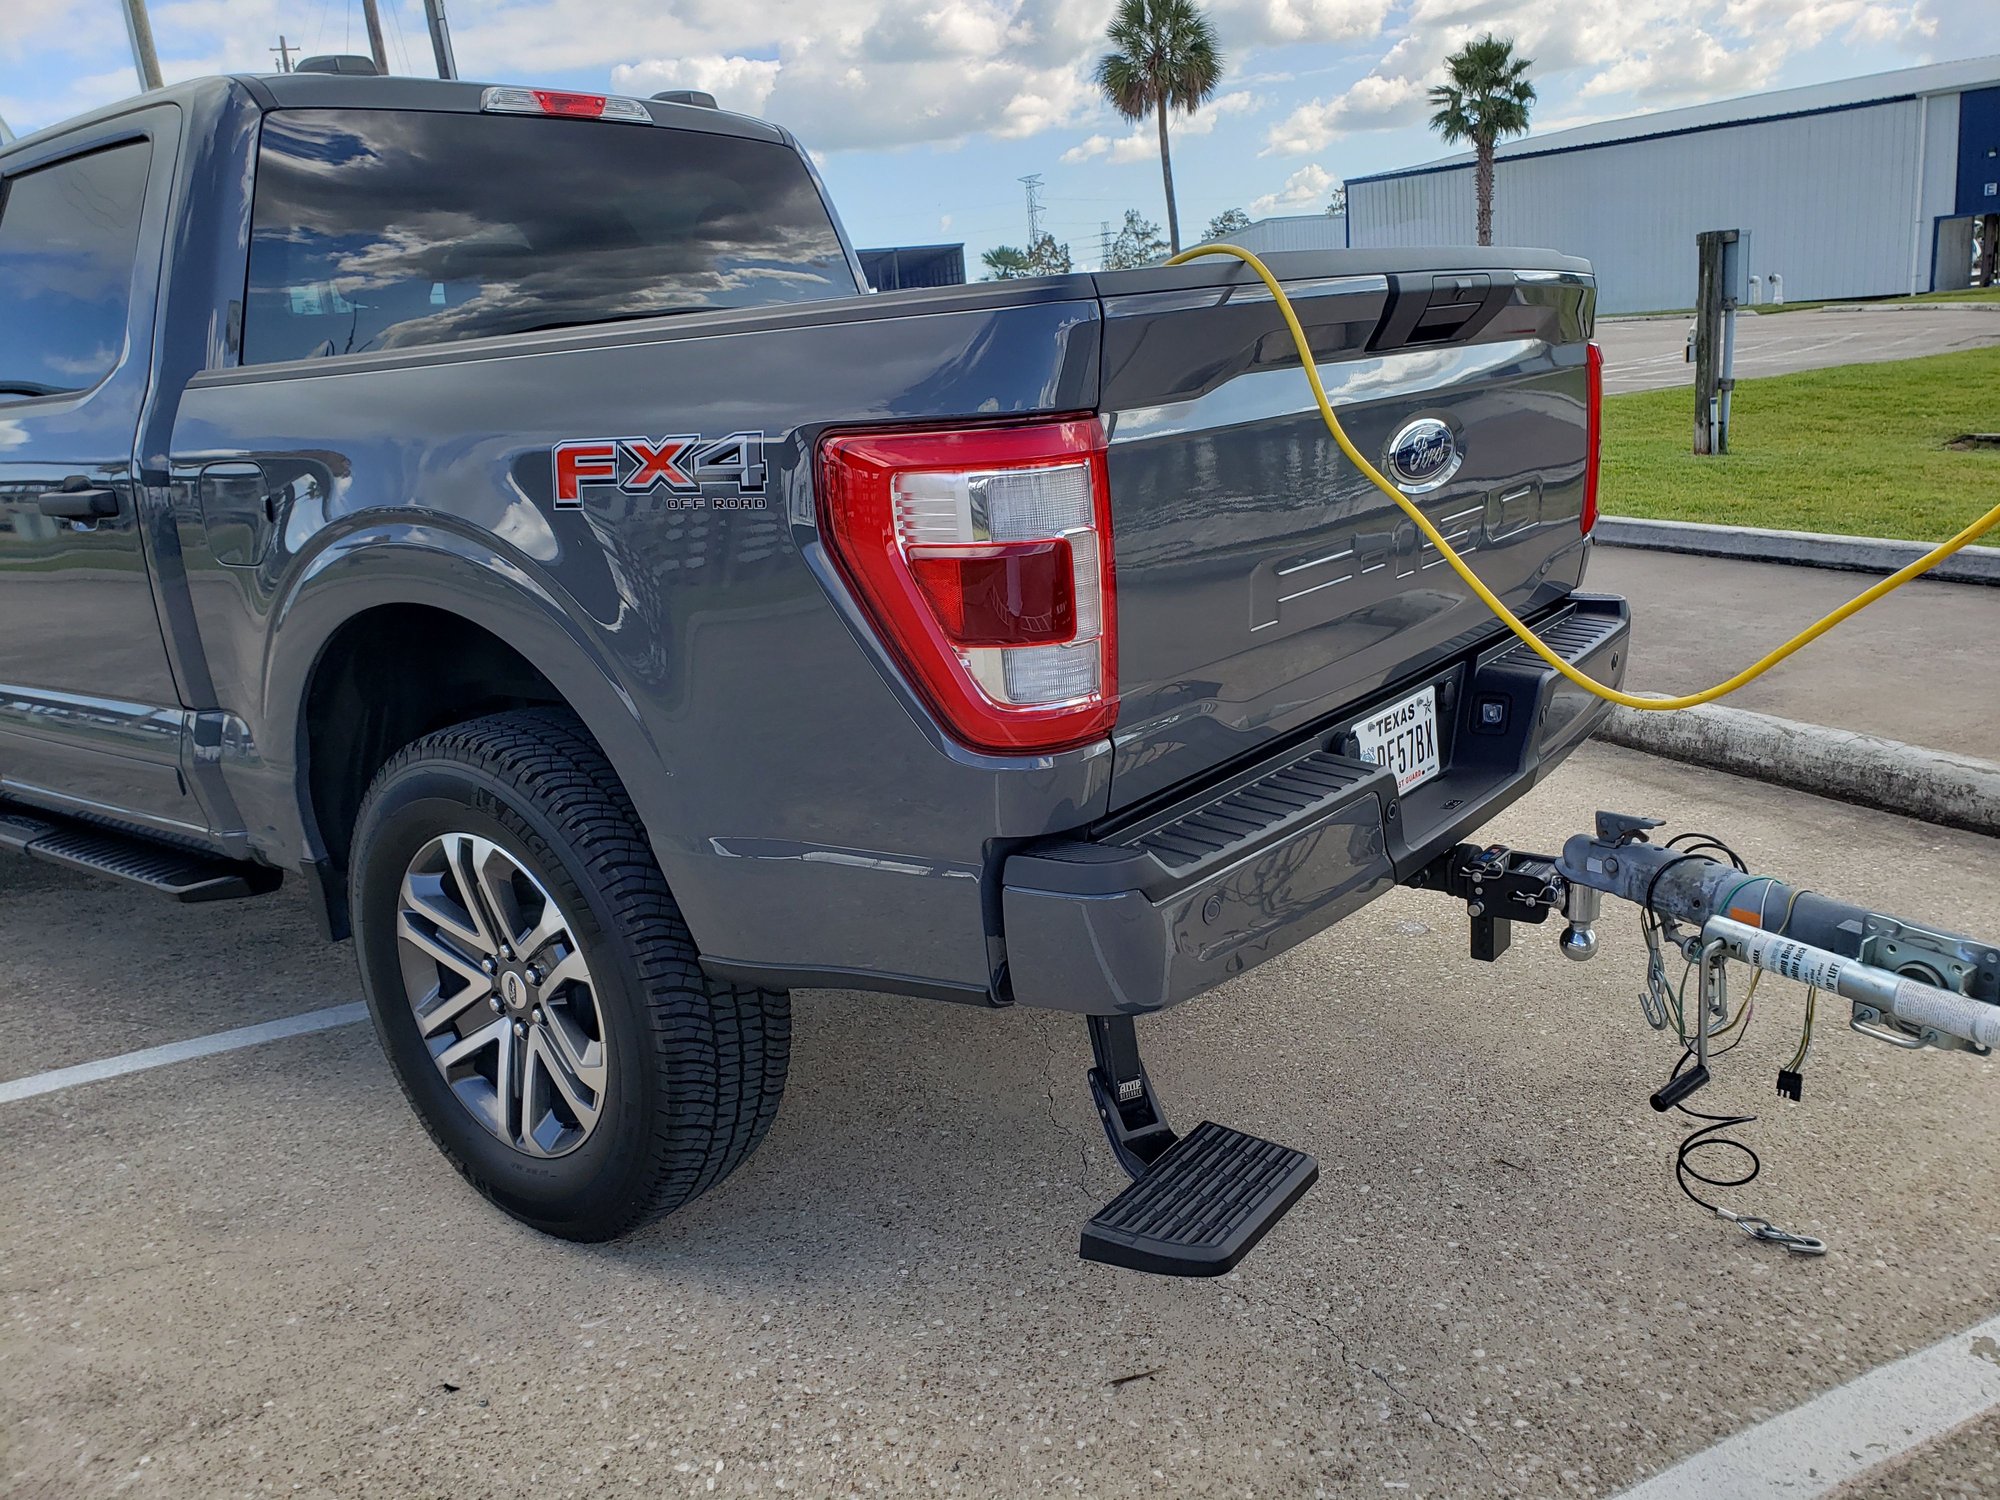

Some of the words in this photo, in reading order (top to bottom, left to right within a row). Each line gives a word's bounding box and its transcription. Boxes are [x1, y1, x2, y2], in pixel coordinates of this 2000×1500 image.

[1410, 431, 1445, 472] Ford
[552, 430, 769, 510] FX4
[667, 498, 705, 510] OFF
[712, 497, 767, 509] ROAD
[1375, 703, 1416, 738] TEXAS
[1405, 769, 1422, 785] GUARD
[1793, 947, 1808, 962] Jack
[1829, 962, 1841, 979] LIFT
[1119, 1079, 1141, 1093] AMP
